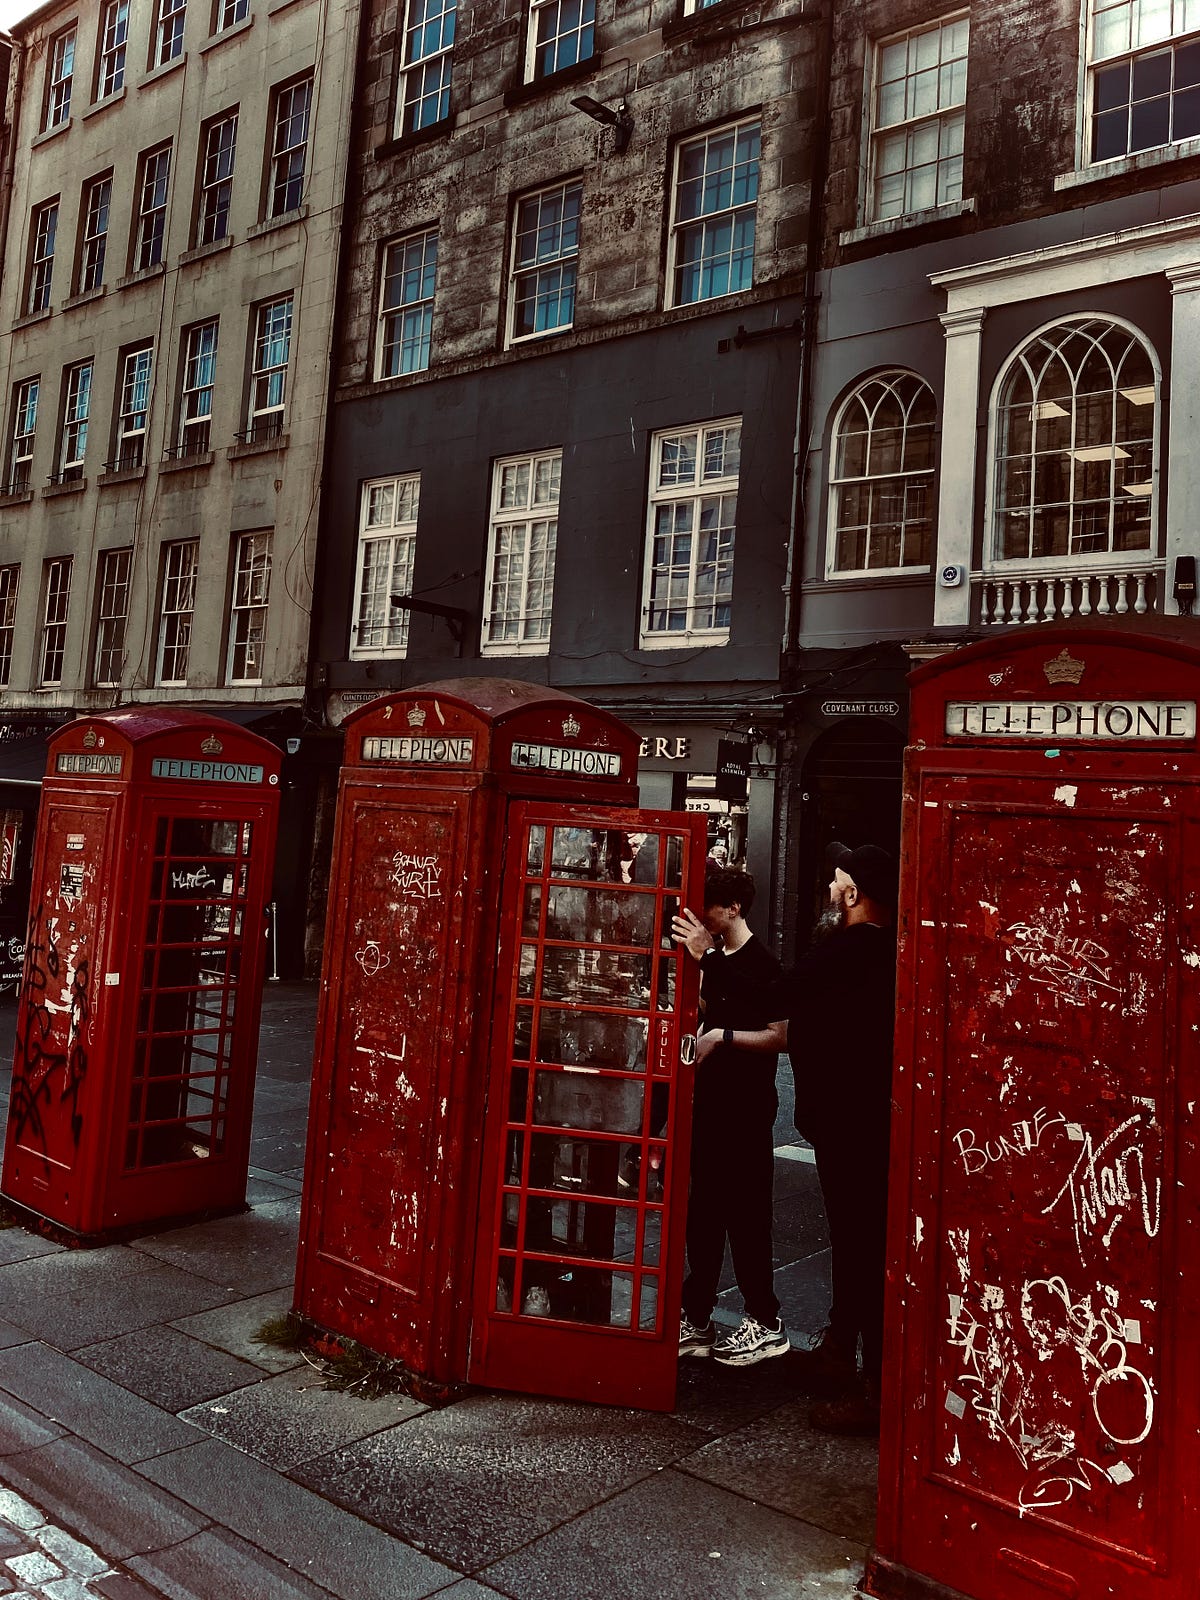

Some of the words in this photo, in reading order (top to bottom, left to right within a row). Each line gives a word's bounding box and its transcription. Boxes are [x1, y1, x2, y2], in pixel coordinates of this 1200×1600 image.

[825, 704, 866, 712] COVENANT
[869, 704, 895, 712] CLOSE
[955, 705, 1187, 736] TELEPHONE
[368, 739, 472, 761] TELEPHONE
[514, 743, 618, 775] TELEPHONE
[60, 756, 121, 773] TELEPHONE
[155, 760, 259, 782] TELEPHONE
[721, 767, 746, 776] CASHMERE
[726, 762, 741, 770] ROYAL
[659, 1026, 668, 1068] PULL
